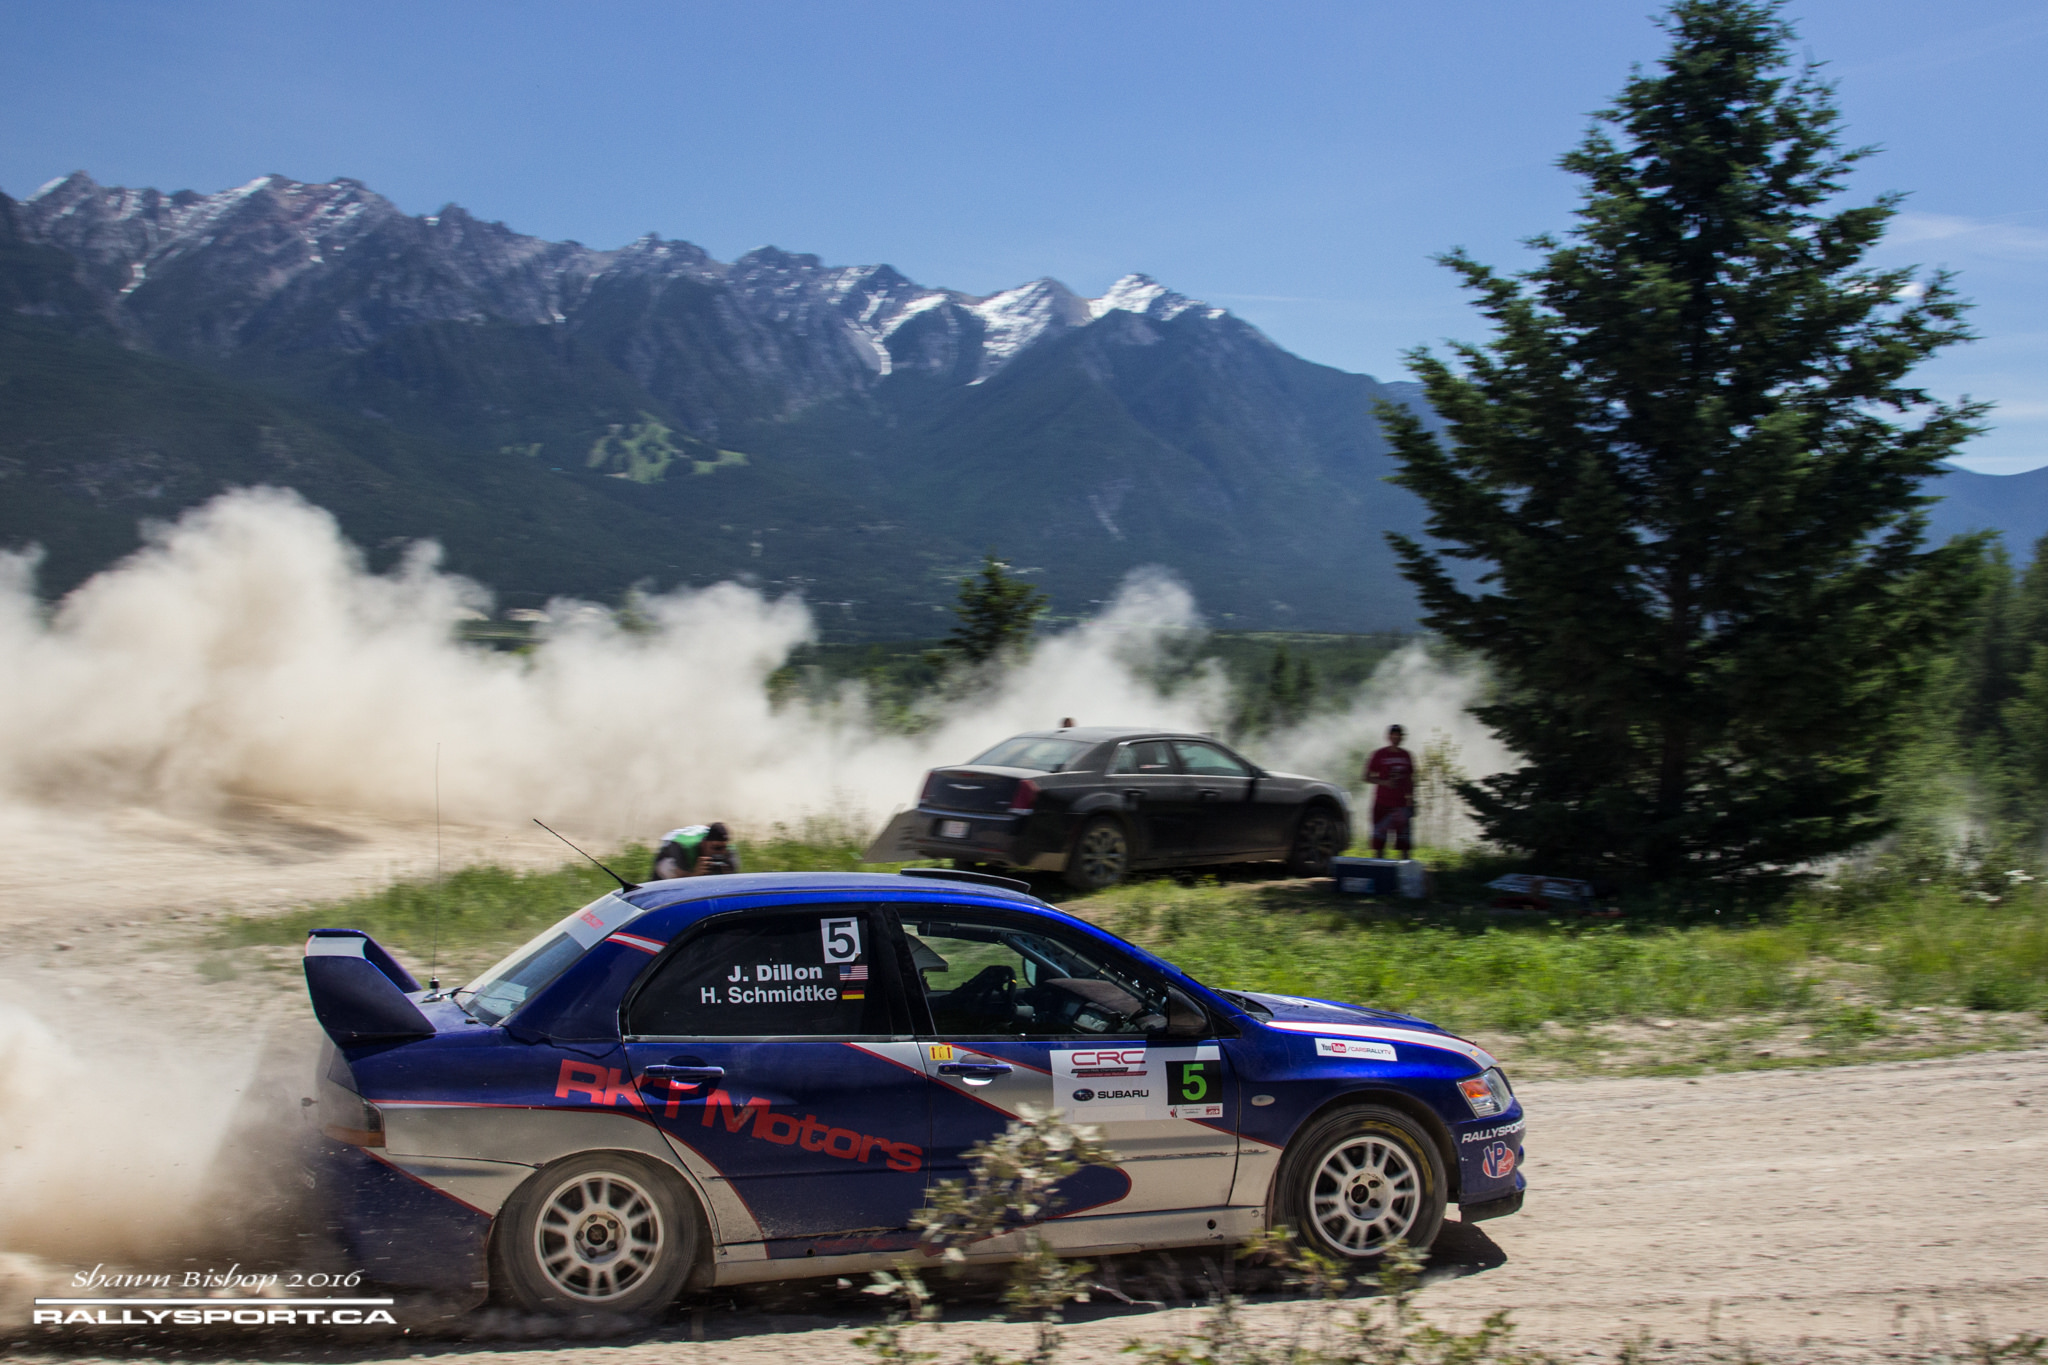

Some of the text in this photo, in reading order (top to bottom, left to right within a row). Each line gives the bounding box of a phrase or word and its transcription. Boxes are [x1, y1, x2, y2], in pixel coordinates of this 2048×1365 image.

[828, 921, 856, 960] 5
[728, 964, 822, 982] J. Dillon
[701, 984, 838, 1004] H. Schmidtke
[1071, 1050, 1146, 1066] CRC
[1097, 1089, 1150, 1099] SUBARU
[1181, 1063, 1208, 1101] 5
[555, 1058, 923, 1174] RKT Motors
[1483, 1141, 1507, 1178] VP
